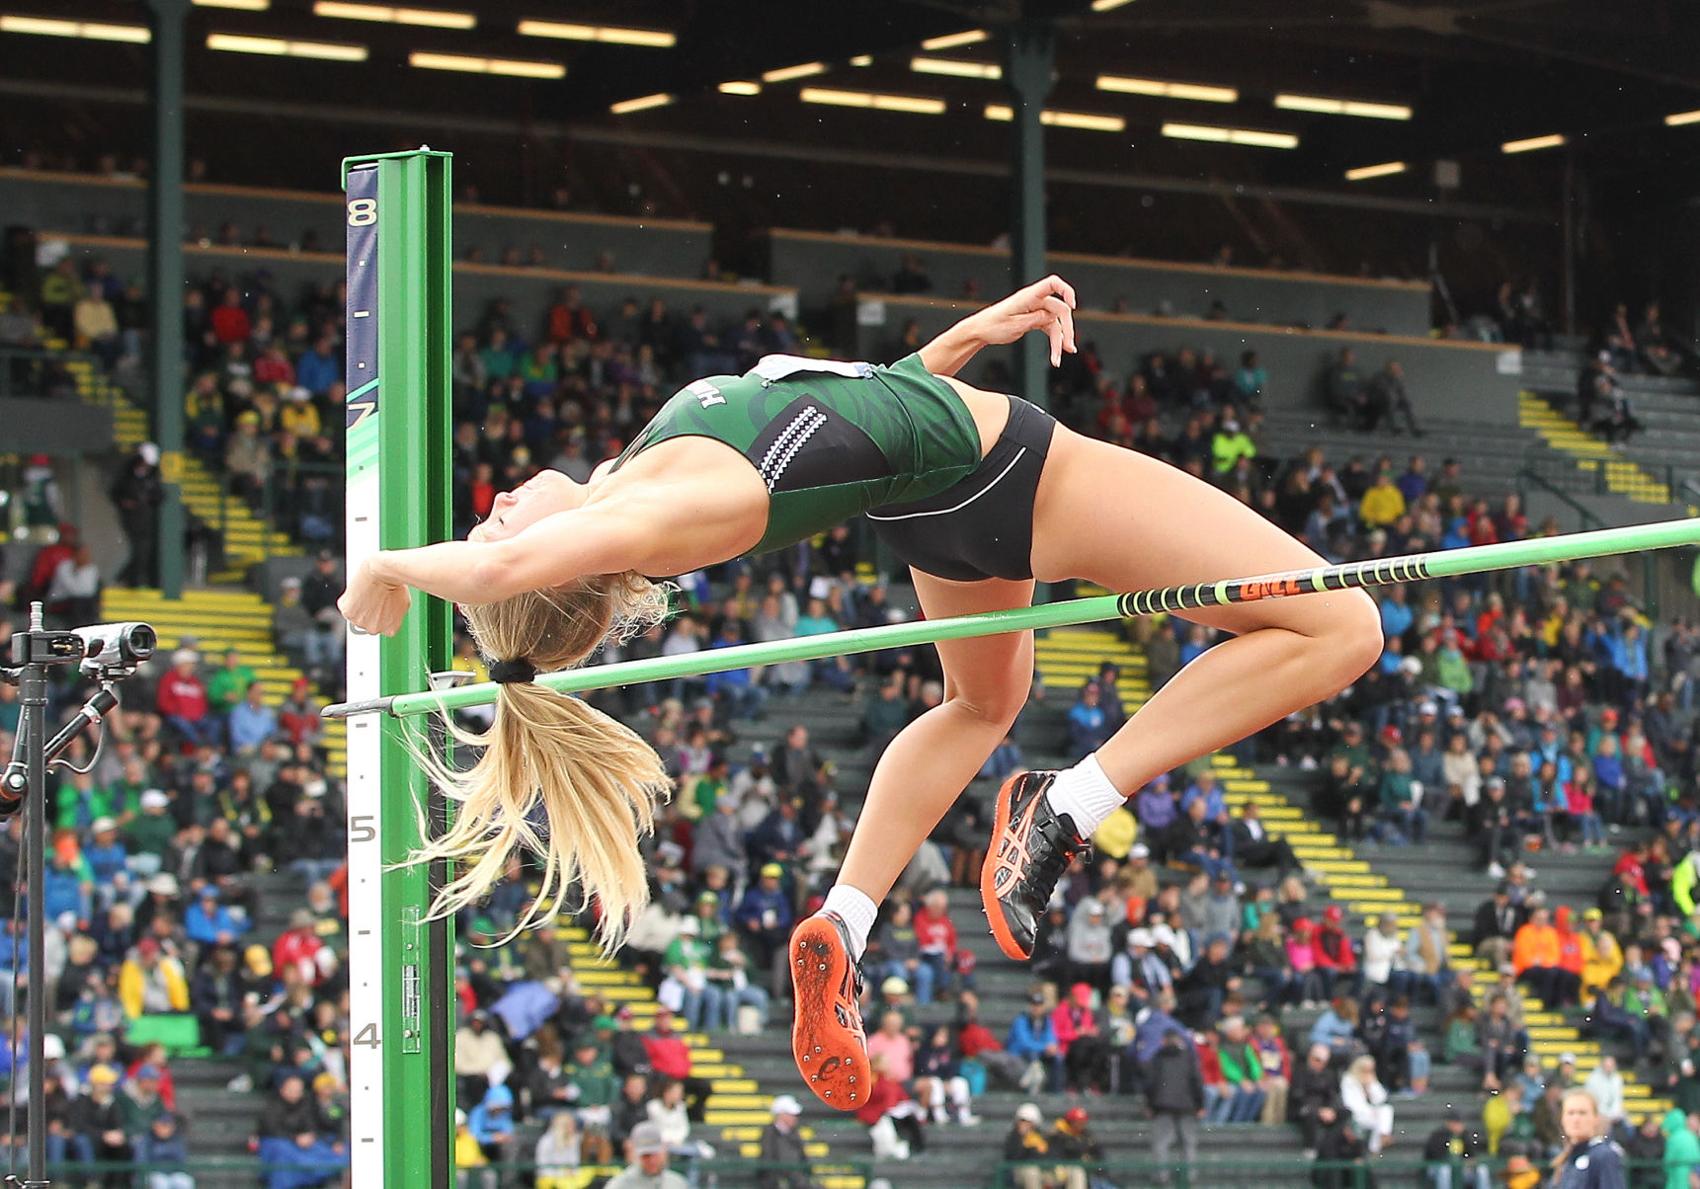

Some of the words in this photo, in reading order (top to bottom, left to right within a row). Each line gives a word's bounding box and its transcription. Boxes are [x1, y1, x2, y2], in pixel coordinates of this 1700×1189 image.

[347, 198, 377, 227] 8
[347, 402, 376, 430] 7
[1240, 577, 1300, 600] GILL
[350, 815, 376, 843] 5
[353, 1022, 381, 1050] 4
